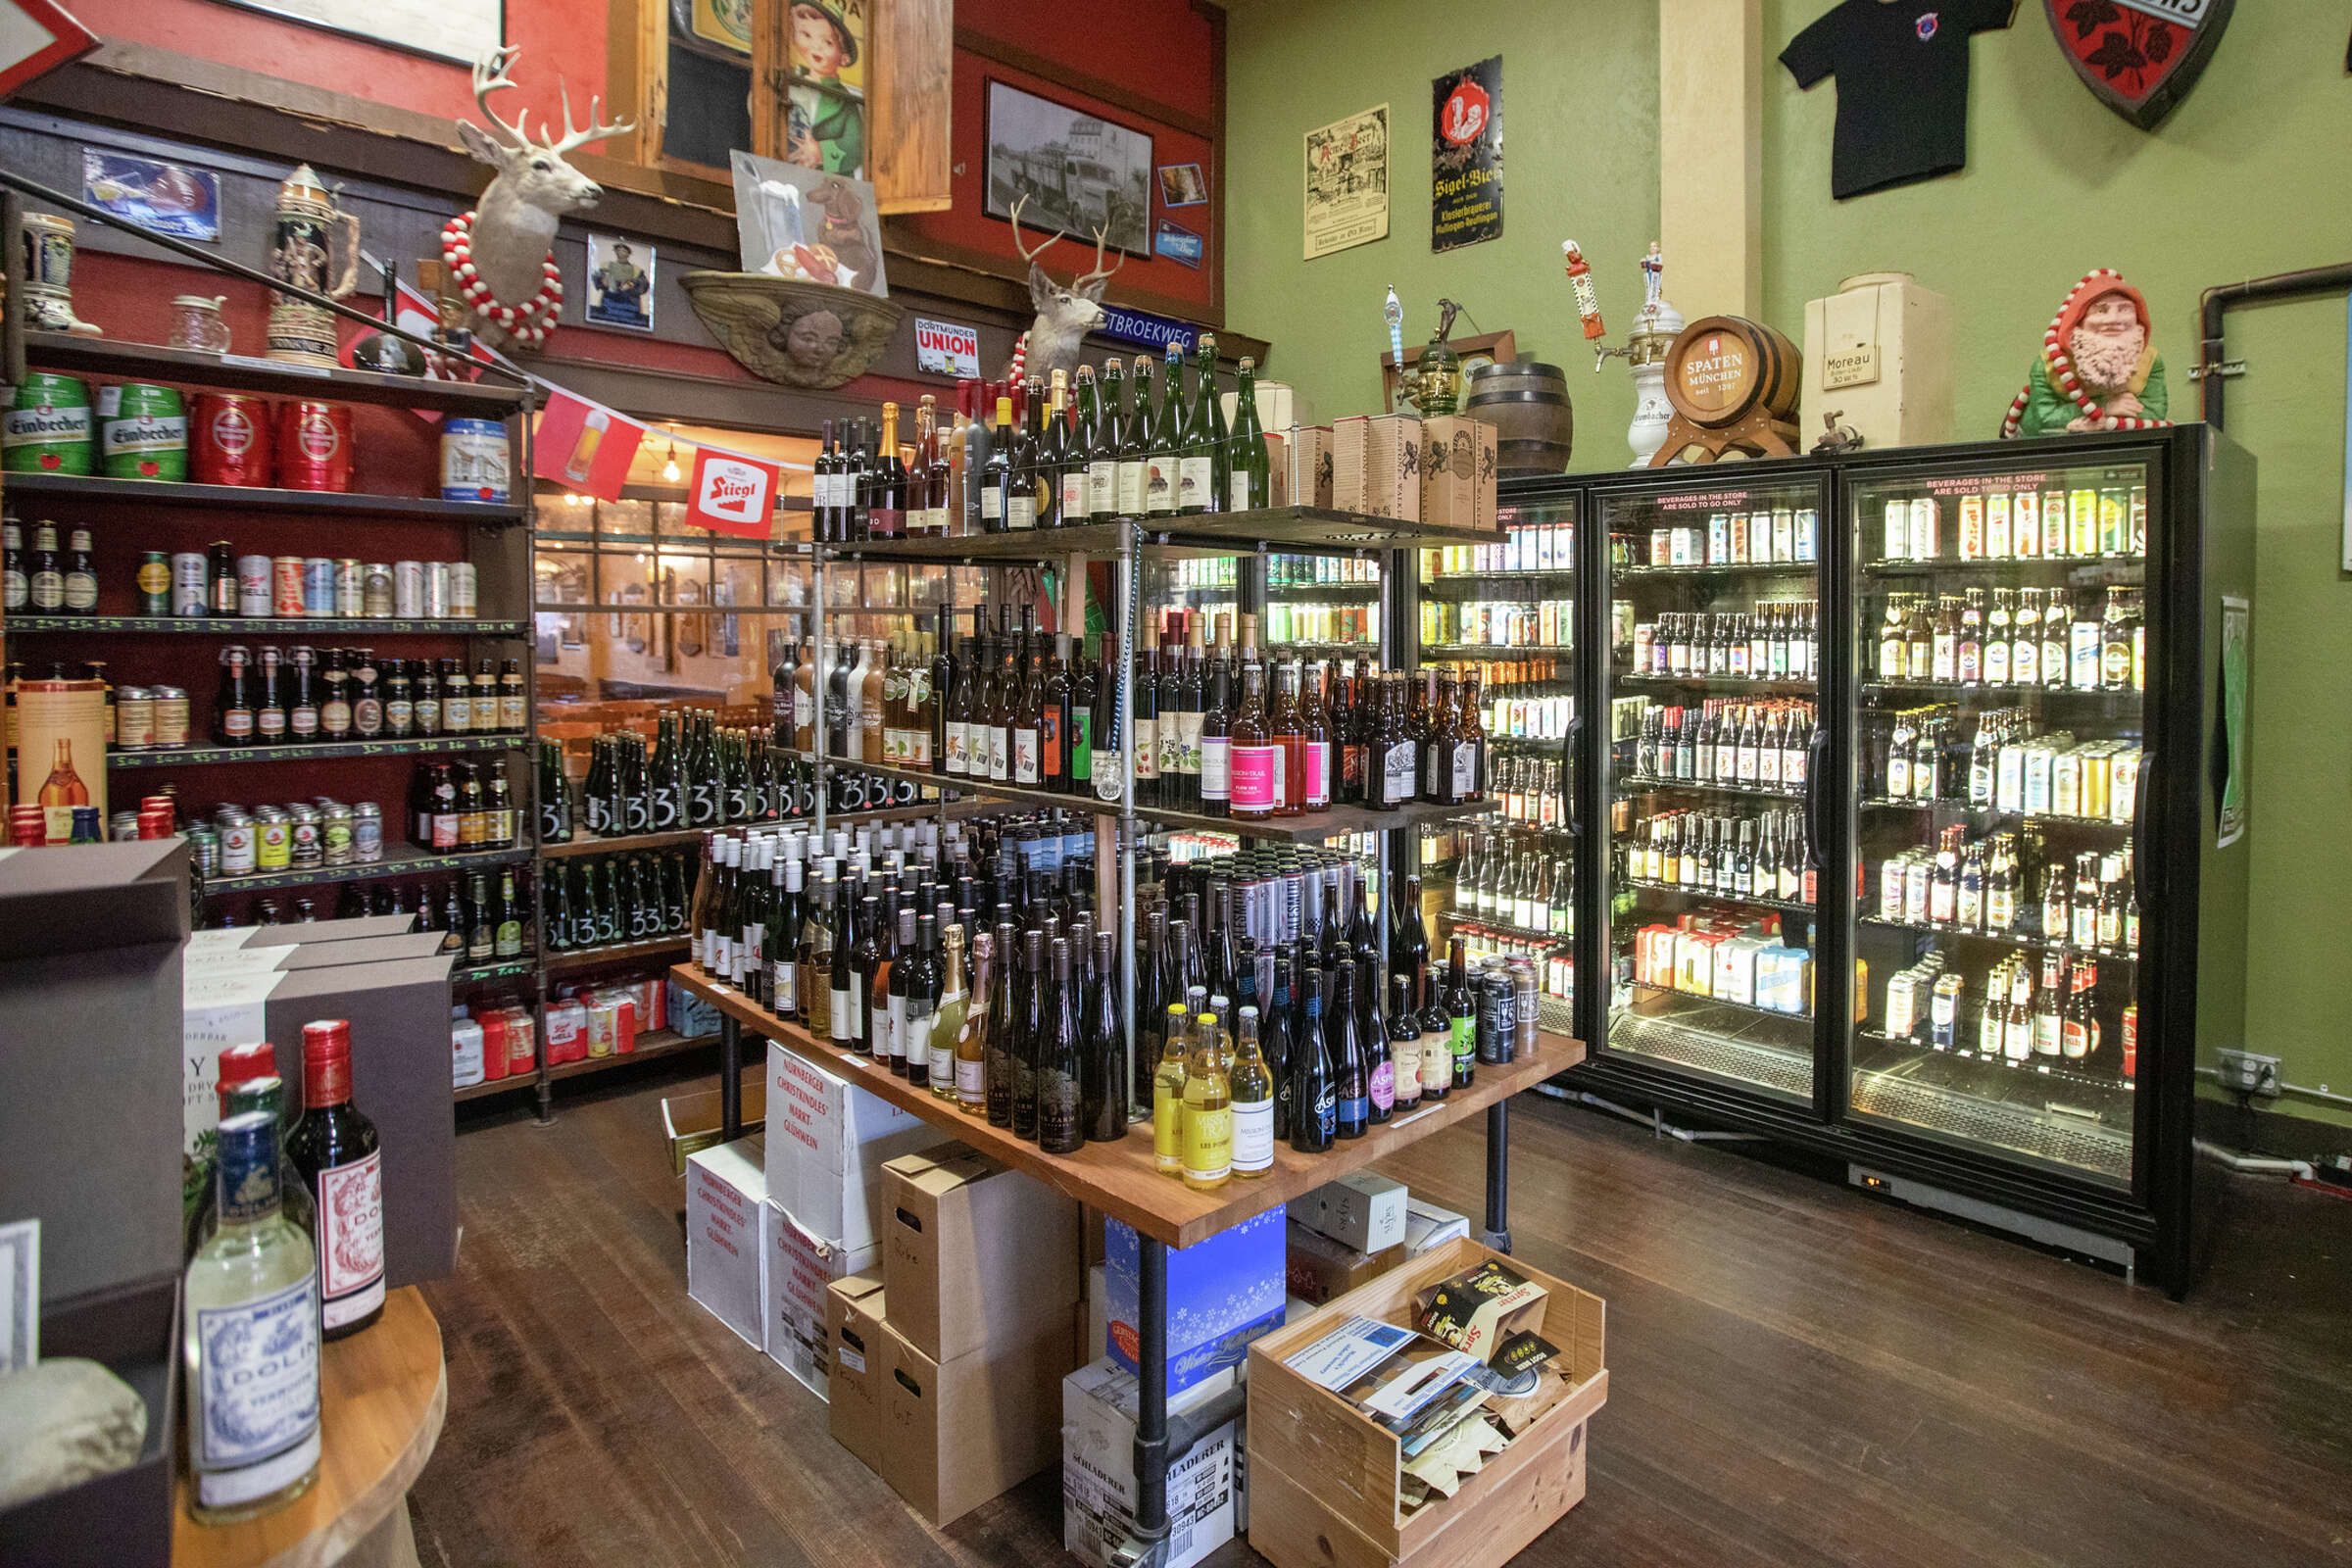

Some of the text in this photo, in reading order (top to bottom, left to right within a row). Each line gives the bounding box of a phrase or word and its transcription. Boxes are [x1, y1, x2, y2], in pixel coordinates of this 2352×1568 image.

[917, 320, 975, 338] DORTMUNDER
[1107, 313, 1193, 349] TBROEKWEG
[918, 329, 976, 358] UNION
[1687, 353, 1743, 374] SPATEN
[1827, 353, 1871, 371] Moreau
[1689, 368, 1742, 386] MÜNCHEN
[710, 475, 757, 500] Stiegl
[1926, 478, 1981, 488] BEVERAGES
[2015, 473, 2047, 483] STORE
[1934, 487, 1952, 496] ARE
[1953, 486, 1979, 495] SOLD
[2013, 482, 2038, 491] ONLY
[1657, 494, 1696, 505] BEVERAGES
[1723, 491, 1747, 501] STORE
[1678, 501, 1697, 510] SOLD
[1709, 500, 1721, 509] GO
[1722, 499, 1742, 508] ONLY
[627, 797, 647, 830] 3
[652, 788, 677, 826] 3
[690, 785, 716, 822] 3
[728, 789, 747, 818] 3
[541, 803, 561, 838] 3
[669, 906, 684, 930] 3
[1287, 878, 1301, 932] ALESMITH
[578, 918, 597, 944] 3
[599, 914, 614, 940] 3
[646, 907, 662, 933] 3
[551, 1031, 573, 1043] HELL
[783, 1058, 824, 1094] NÜRNBERGER
[789, 1102, 812, 1127] MARKT-
[784, 1118, 818, 1151] GLÜHWEIN
[706, 1226, 739, 1258] GLÜHWEIN
[787, 1281, 825, 1318] GLÜHWEIN
[1072, 1450, 1126, 1495] SCHLADERER
